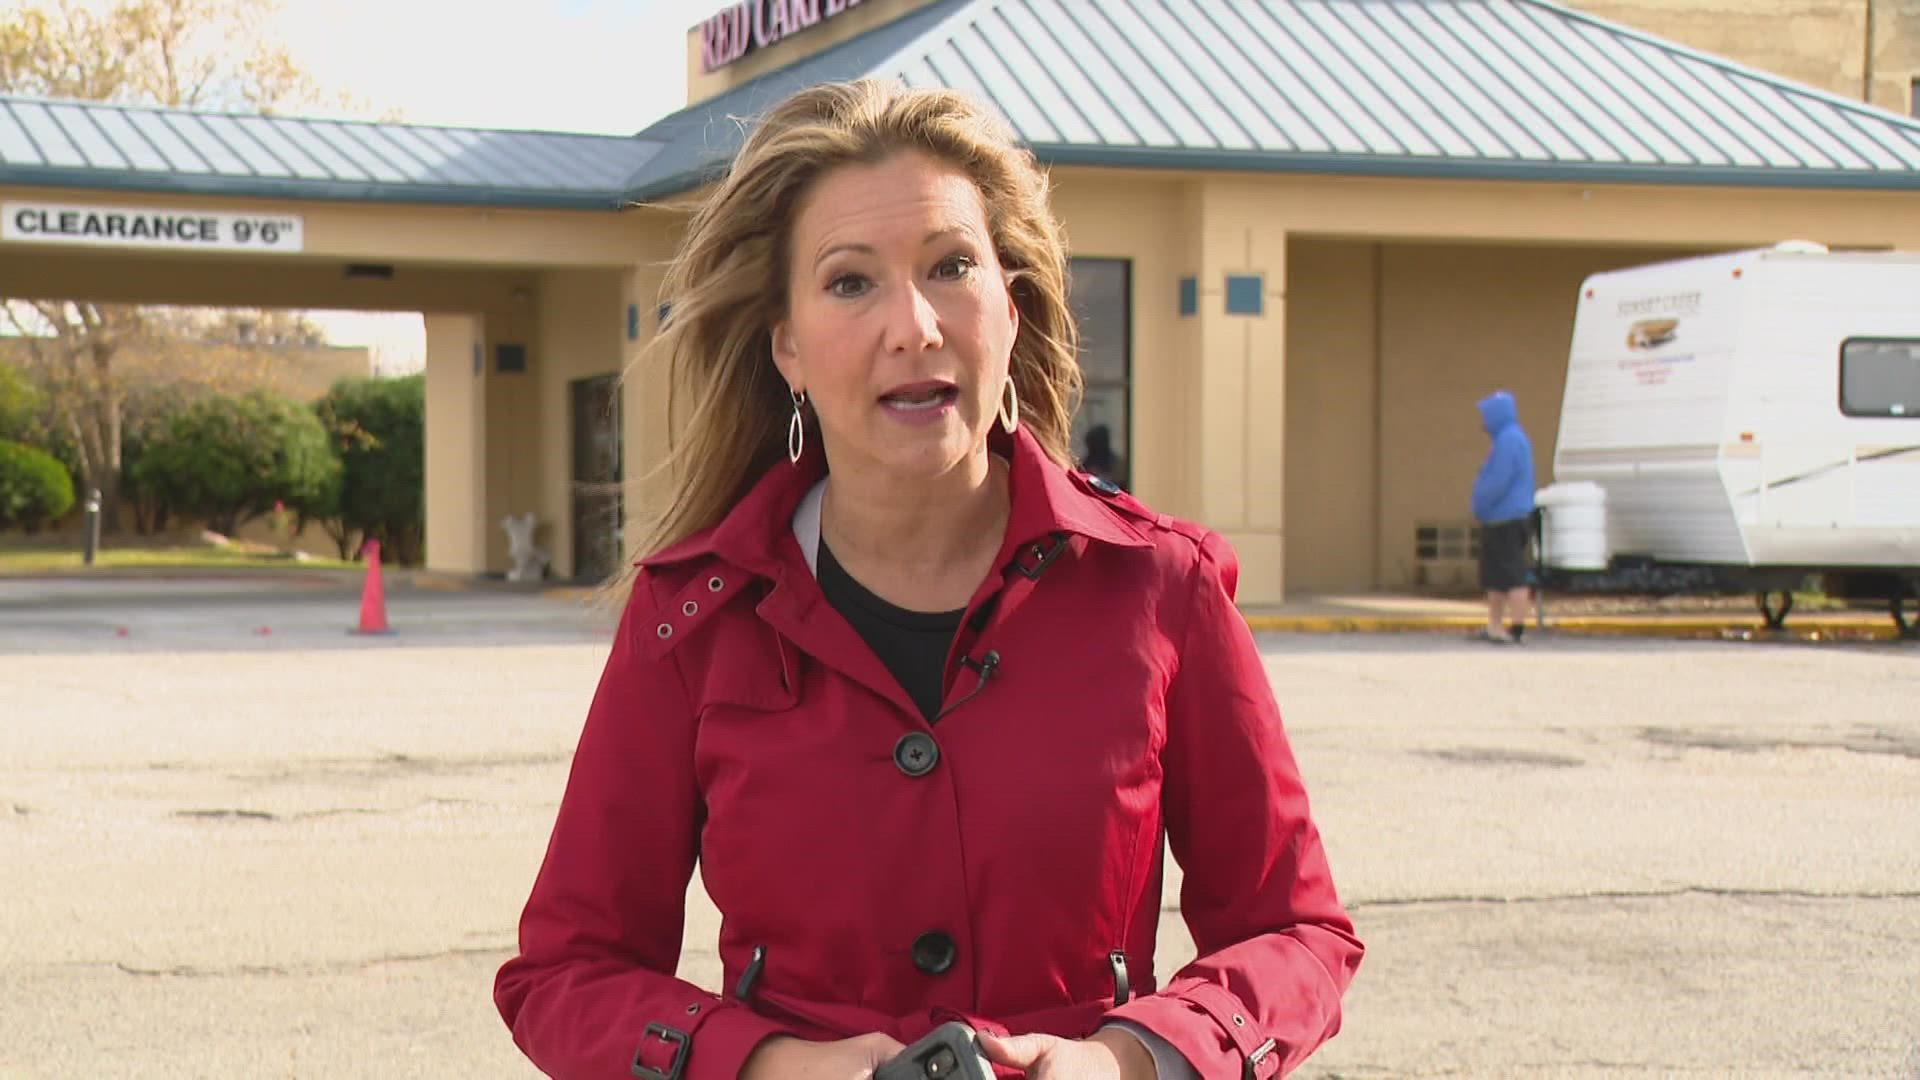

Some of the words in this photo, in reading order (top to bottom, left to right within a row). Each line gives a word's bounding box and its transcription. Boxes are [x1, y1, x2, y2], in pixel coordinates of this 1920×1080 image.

[702, 3, 750, 73] RED
[753, 0, 862, 47] CAR
[14, 208, 219, 243] CLEARANCE
